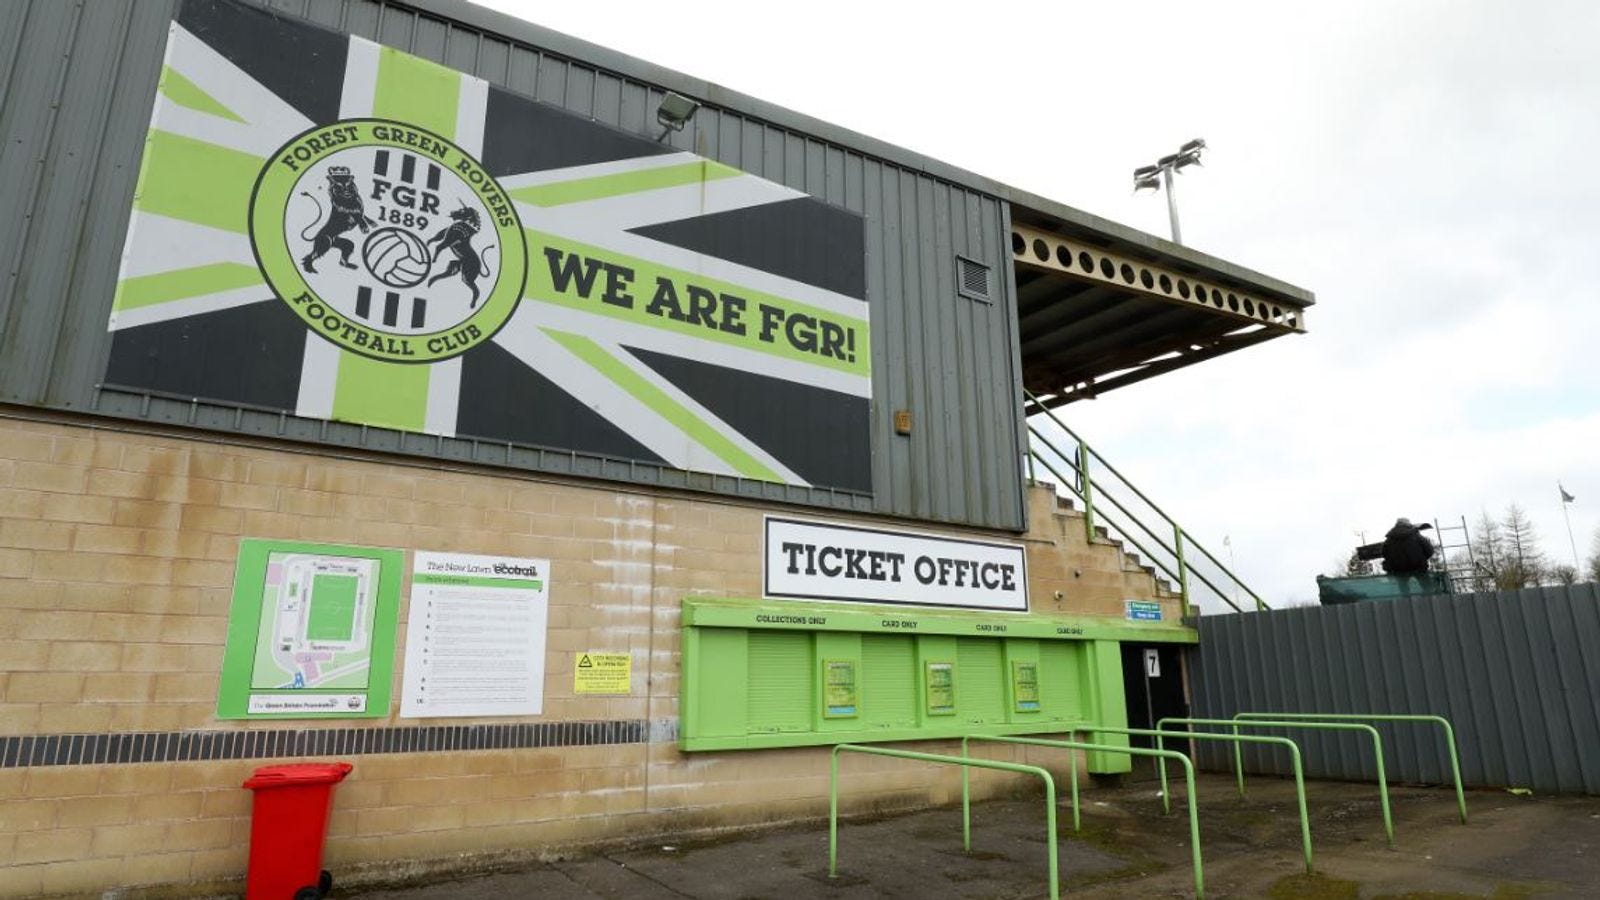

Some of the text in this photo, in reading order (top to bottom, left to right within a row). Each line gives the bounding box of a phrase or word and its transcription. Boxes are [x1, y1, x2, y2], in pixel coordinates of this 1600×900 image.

[282, 125, 515, 229] FOREST GREEN ROVERS
[370, 177, 441, 215] FGR
[377, 206, 429, 231] 1889
[543, 246, 856, 364] WE ARE FGR!
[292, 290, 483, 357] FOOTBALL CLUB
[427, 561, 444, 572] The
[445, 562, 465, 573] New
[467, 564, 491, 575] Lawn
[782, 541, 1017, 591] TICKET OFFICE
[756, 614, 827, 625] COLLECTIONS ONLY
[881, 619, 918, 629] CARD ONLY
[1148, 655, 1156, 674] 7
